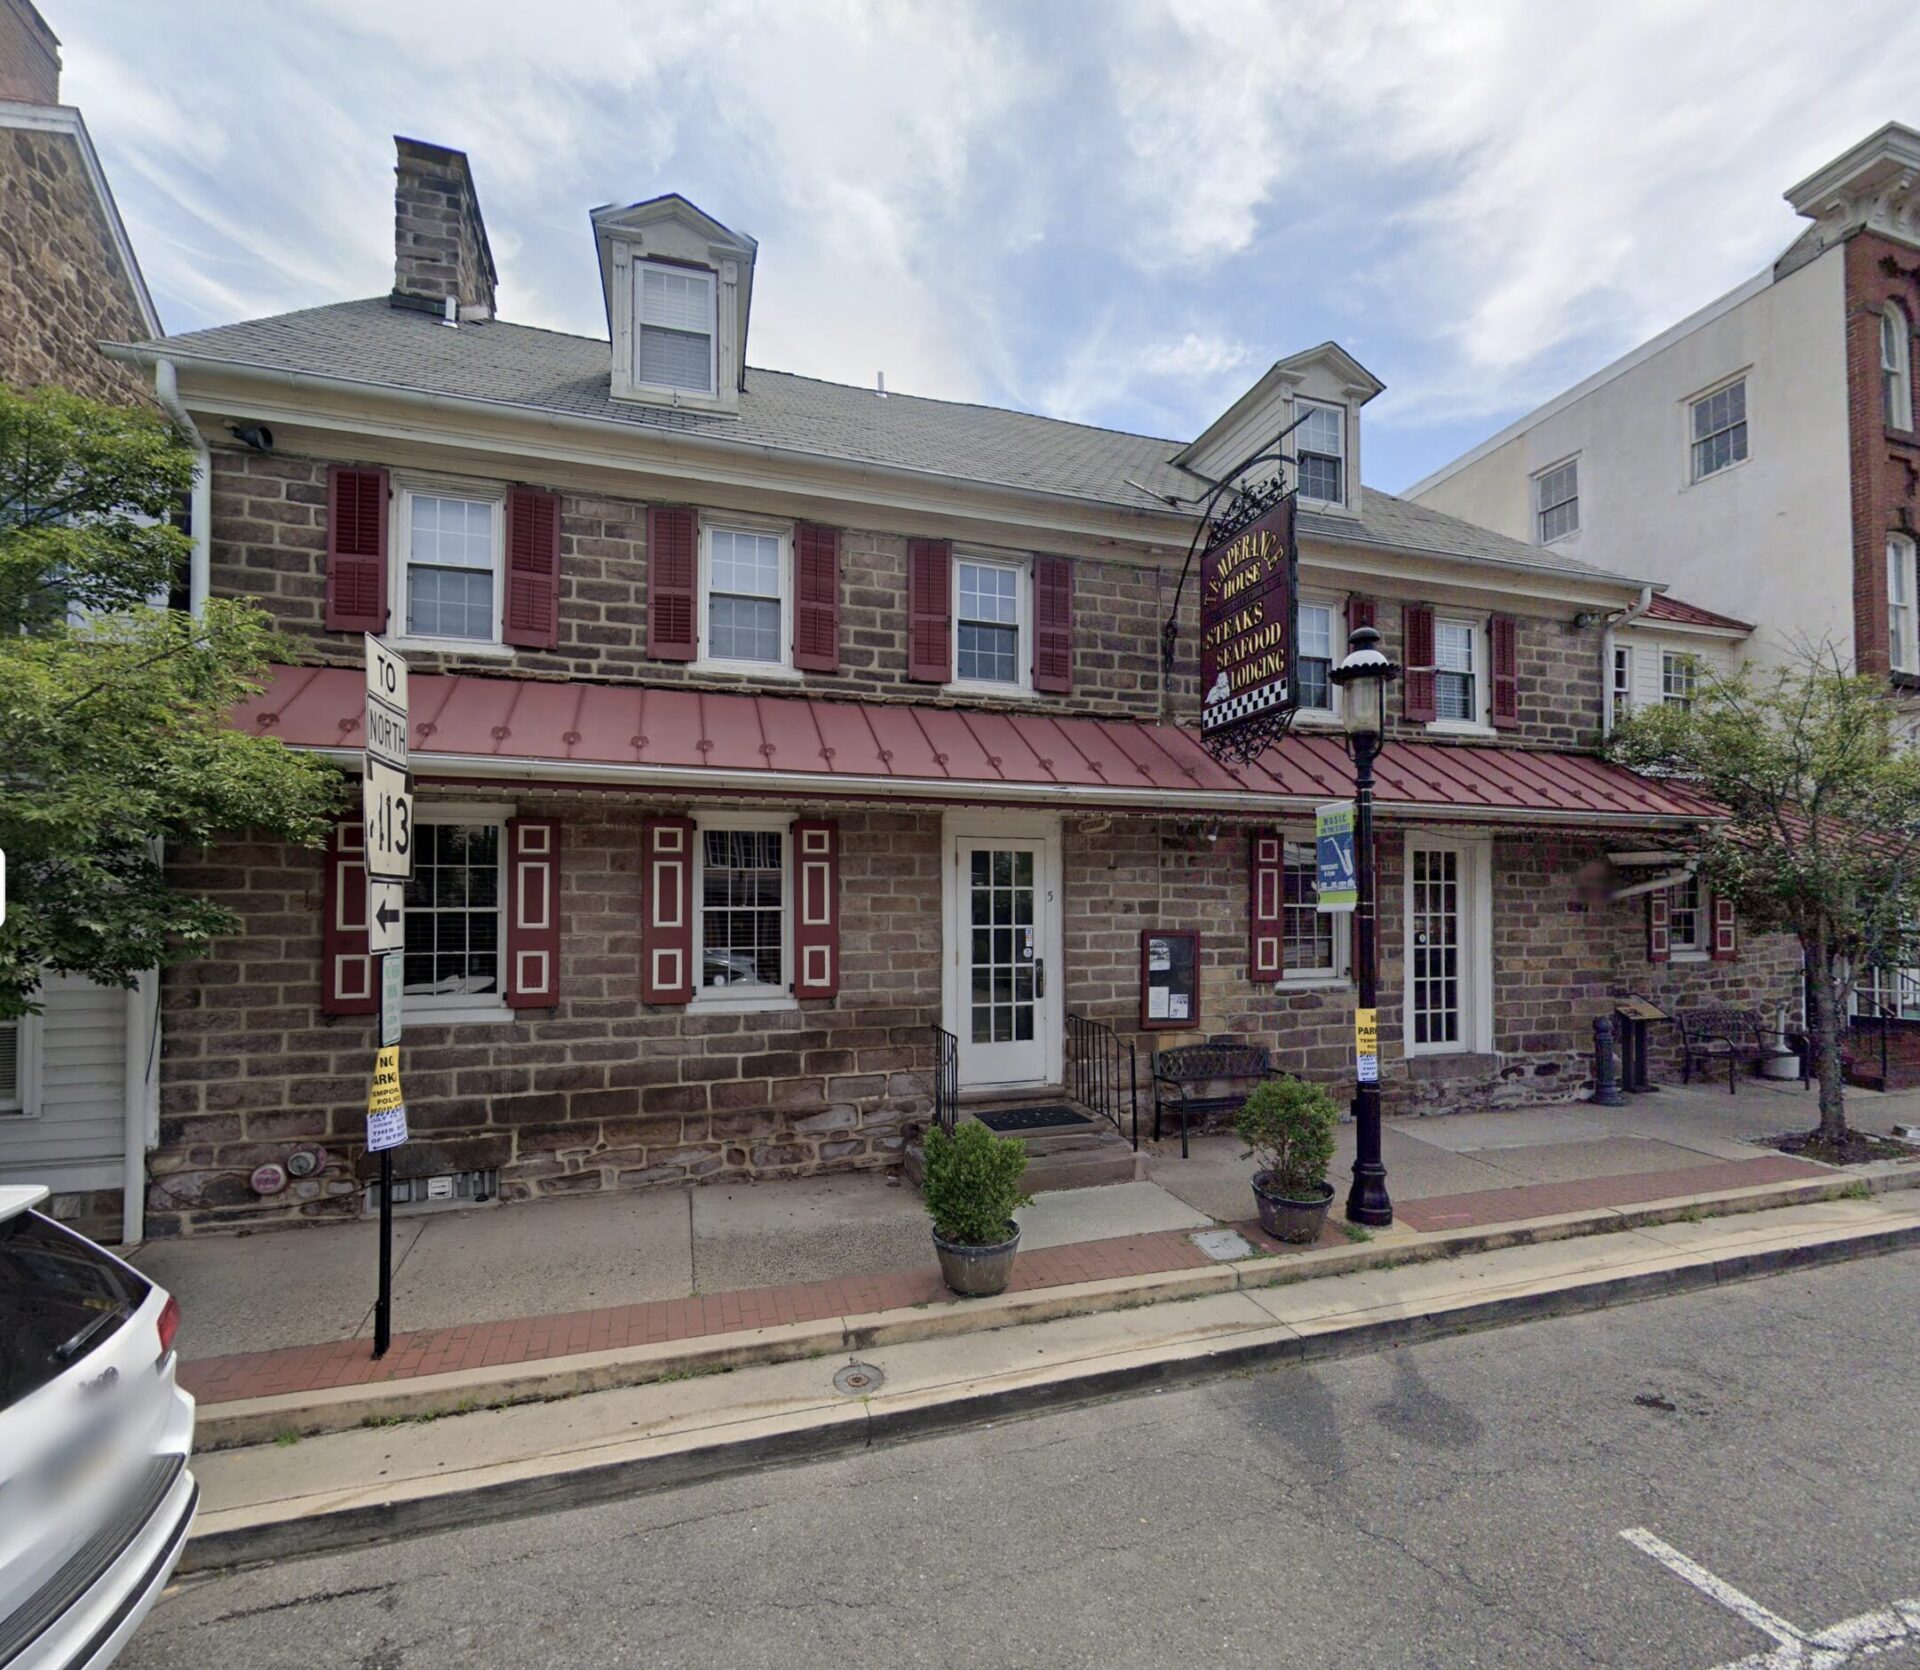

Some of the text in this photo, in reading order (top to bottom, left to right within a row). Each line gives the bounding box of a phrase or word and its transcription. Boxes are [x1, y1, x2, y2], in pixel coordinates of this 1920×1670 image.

[1204, 530, 1284, 605] TEMPERANCE
[1224, 562, 1261, 600] HOUSE
[1206, 602, 1263, 650] STEAKS
[1216, 622, 1281, 670] SEAFOOD
[377, 654, 396, 693] TO
[1231, 649, 1285, 691] LODGING
[369, 709, 406, 756] NORTH
[1323, 814, 1347, 826] MUSIC
[1047, 890, 1054, 903] 5
